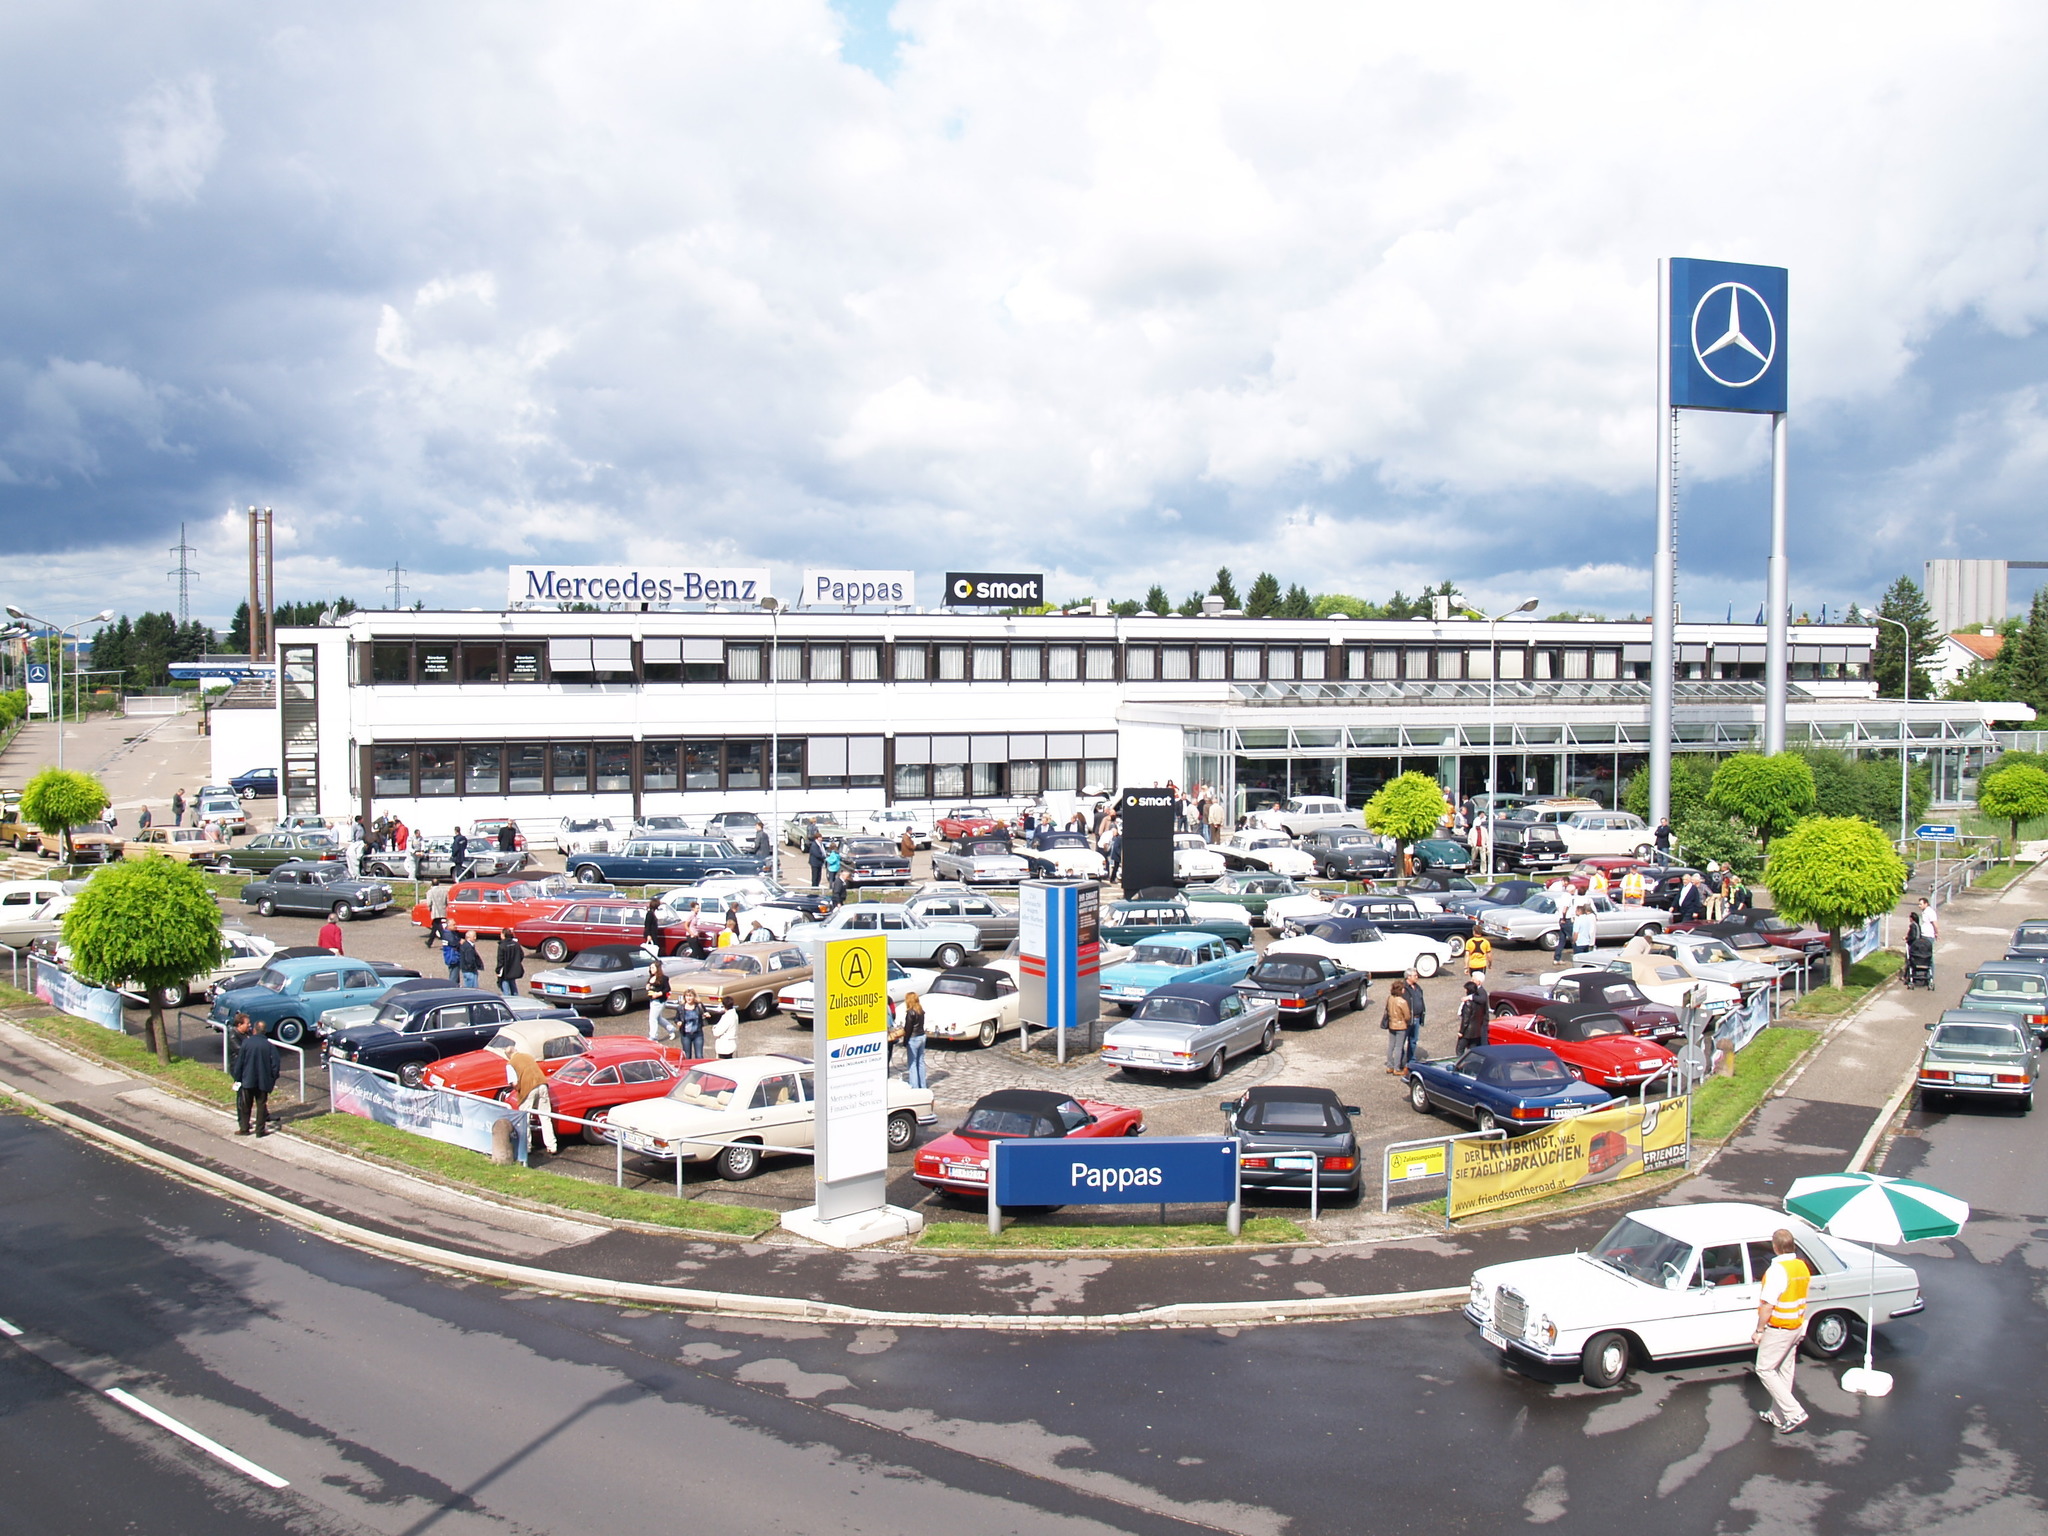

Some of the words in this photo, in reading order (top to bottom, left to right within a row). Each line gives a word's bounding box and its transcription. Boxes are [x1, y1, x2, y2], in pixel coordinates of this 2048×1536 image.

[525, 570, 758, 602] Mercedes-Benz
[817, 576, 903, 604] Pappas
[976, 580, 1038, 600] smart
[1138, 796, 1172, 807] smart
[829, 992, 883, 1010] Zulassungs-
[844, 1008, 869, 1026] stelle
[1465, 1149, 1480, 1163] DER
[1480, 1140, 1513, 1161] LKW
[1514, 1134, 1557, 1154] BRINGT,
[1557, 1134, 1576, 1146] WAS
[1643, 1144, 1686, 1164] FRIENDS
[1455, 1168, 1468, 1179] SIE
[1470, 1158, 1513, 1179] TÄGLICH
[1512, 1144, 1585, 1172] BRAUCHEN.
[1655, 1159, 1668, 1168] the
[1668, 1155, 1686, 1165] road
[1071, 1162, 1162, 1191] Pappas
[1454, 1178, 1567, 1212] www.friendsontheroad.at
